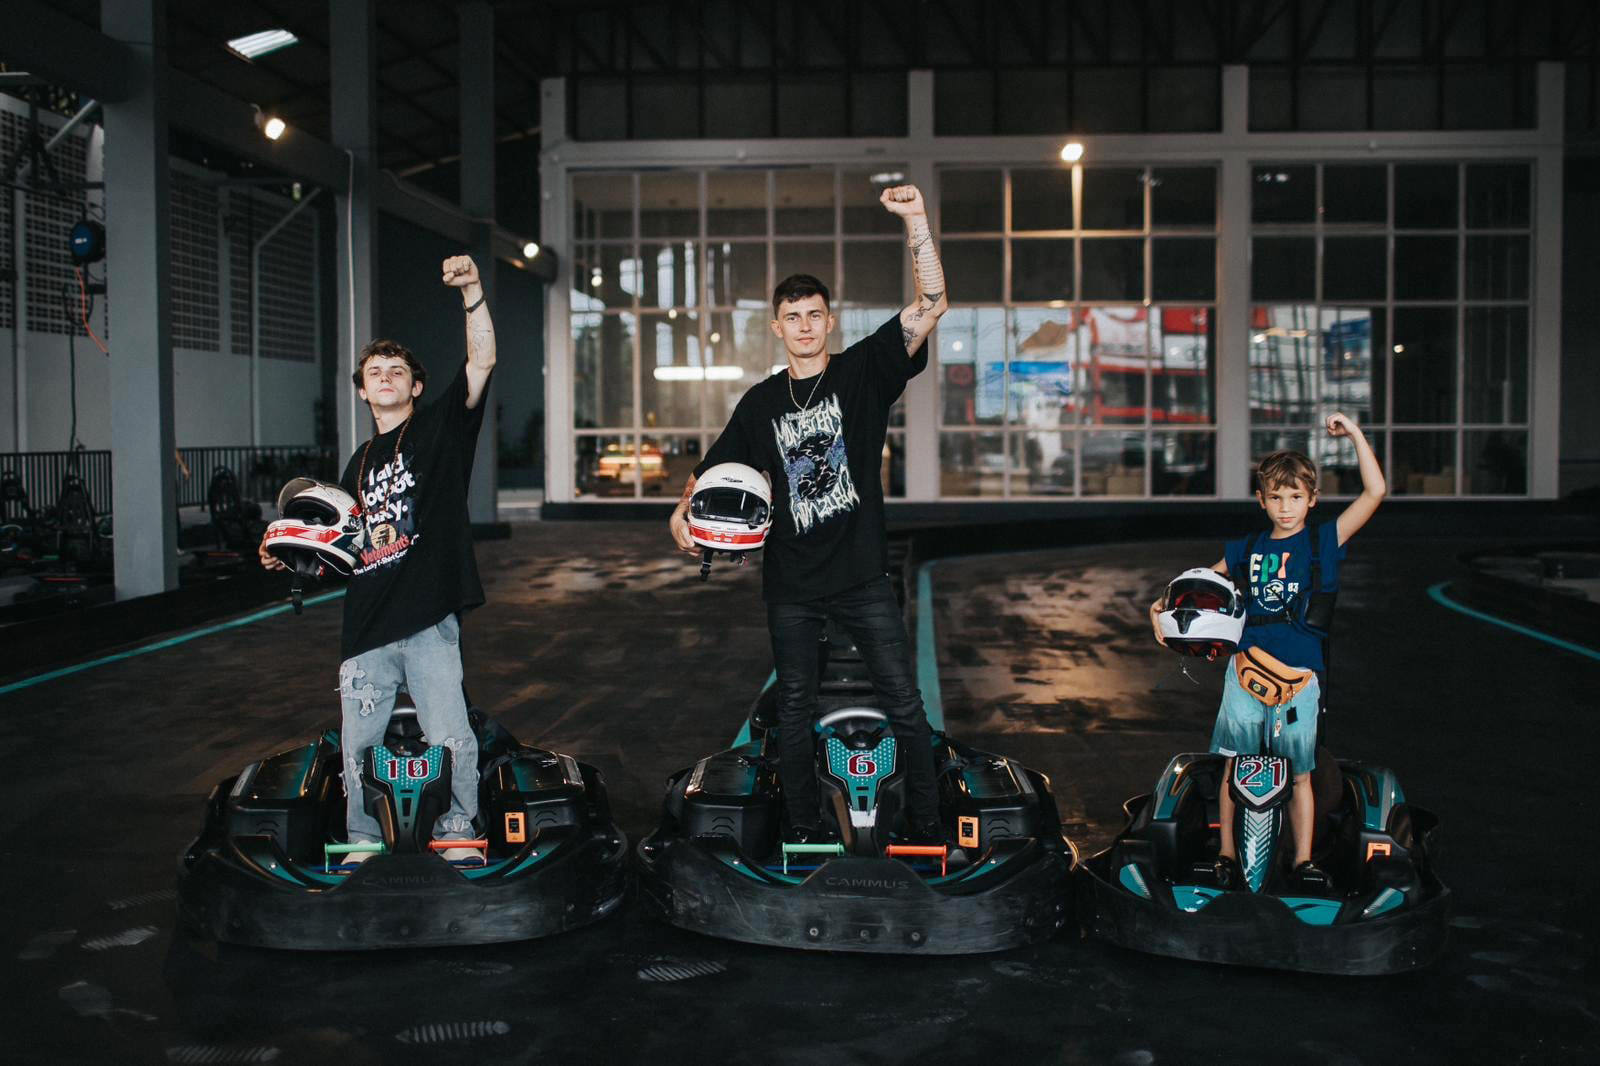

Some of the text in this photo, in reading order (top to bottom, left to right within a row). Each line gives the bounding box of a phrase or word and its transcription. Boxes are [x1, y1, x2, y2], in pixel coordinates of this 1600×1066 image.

[384, 759, 429, 780] 10
[847, 753, 877, 777] 6
[1240, 760, 1283, 787] 21
[362, 873, 446, 888] CAMMU
[826, 877, 909, 889] CAMMUS
